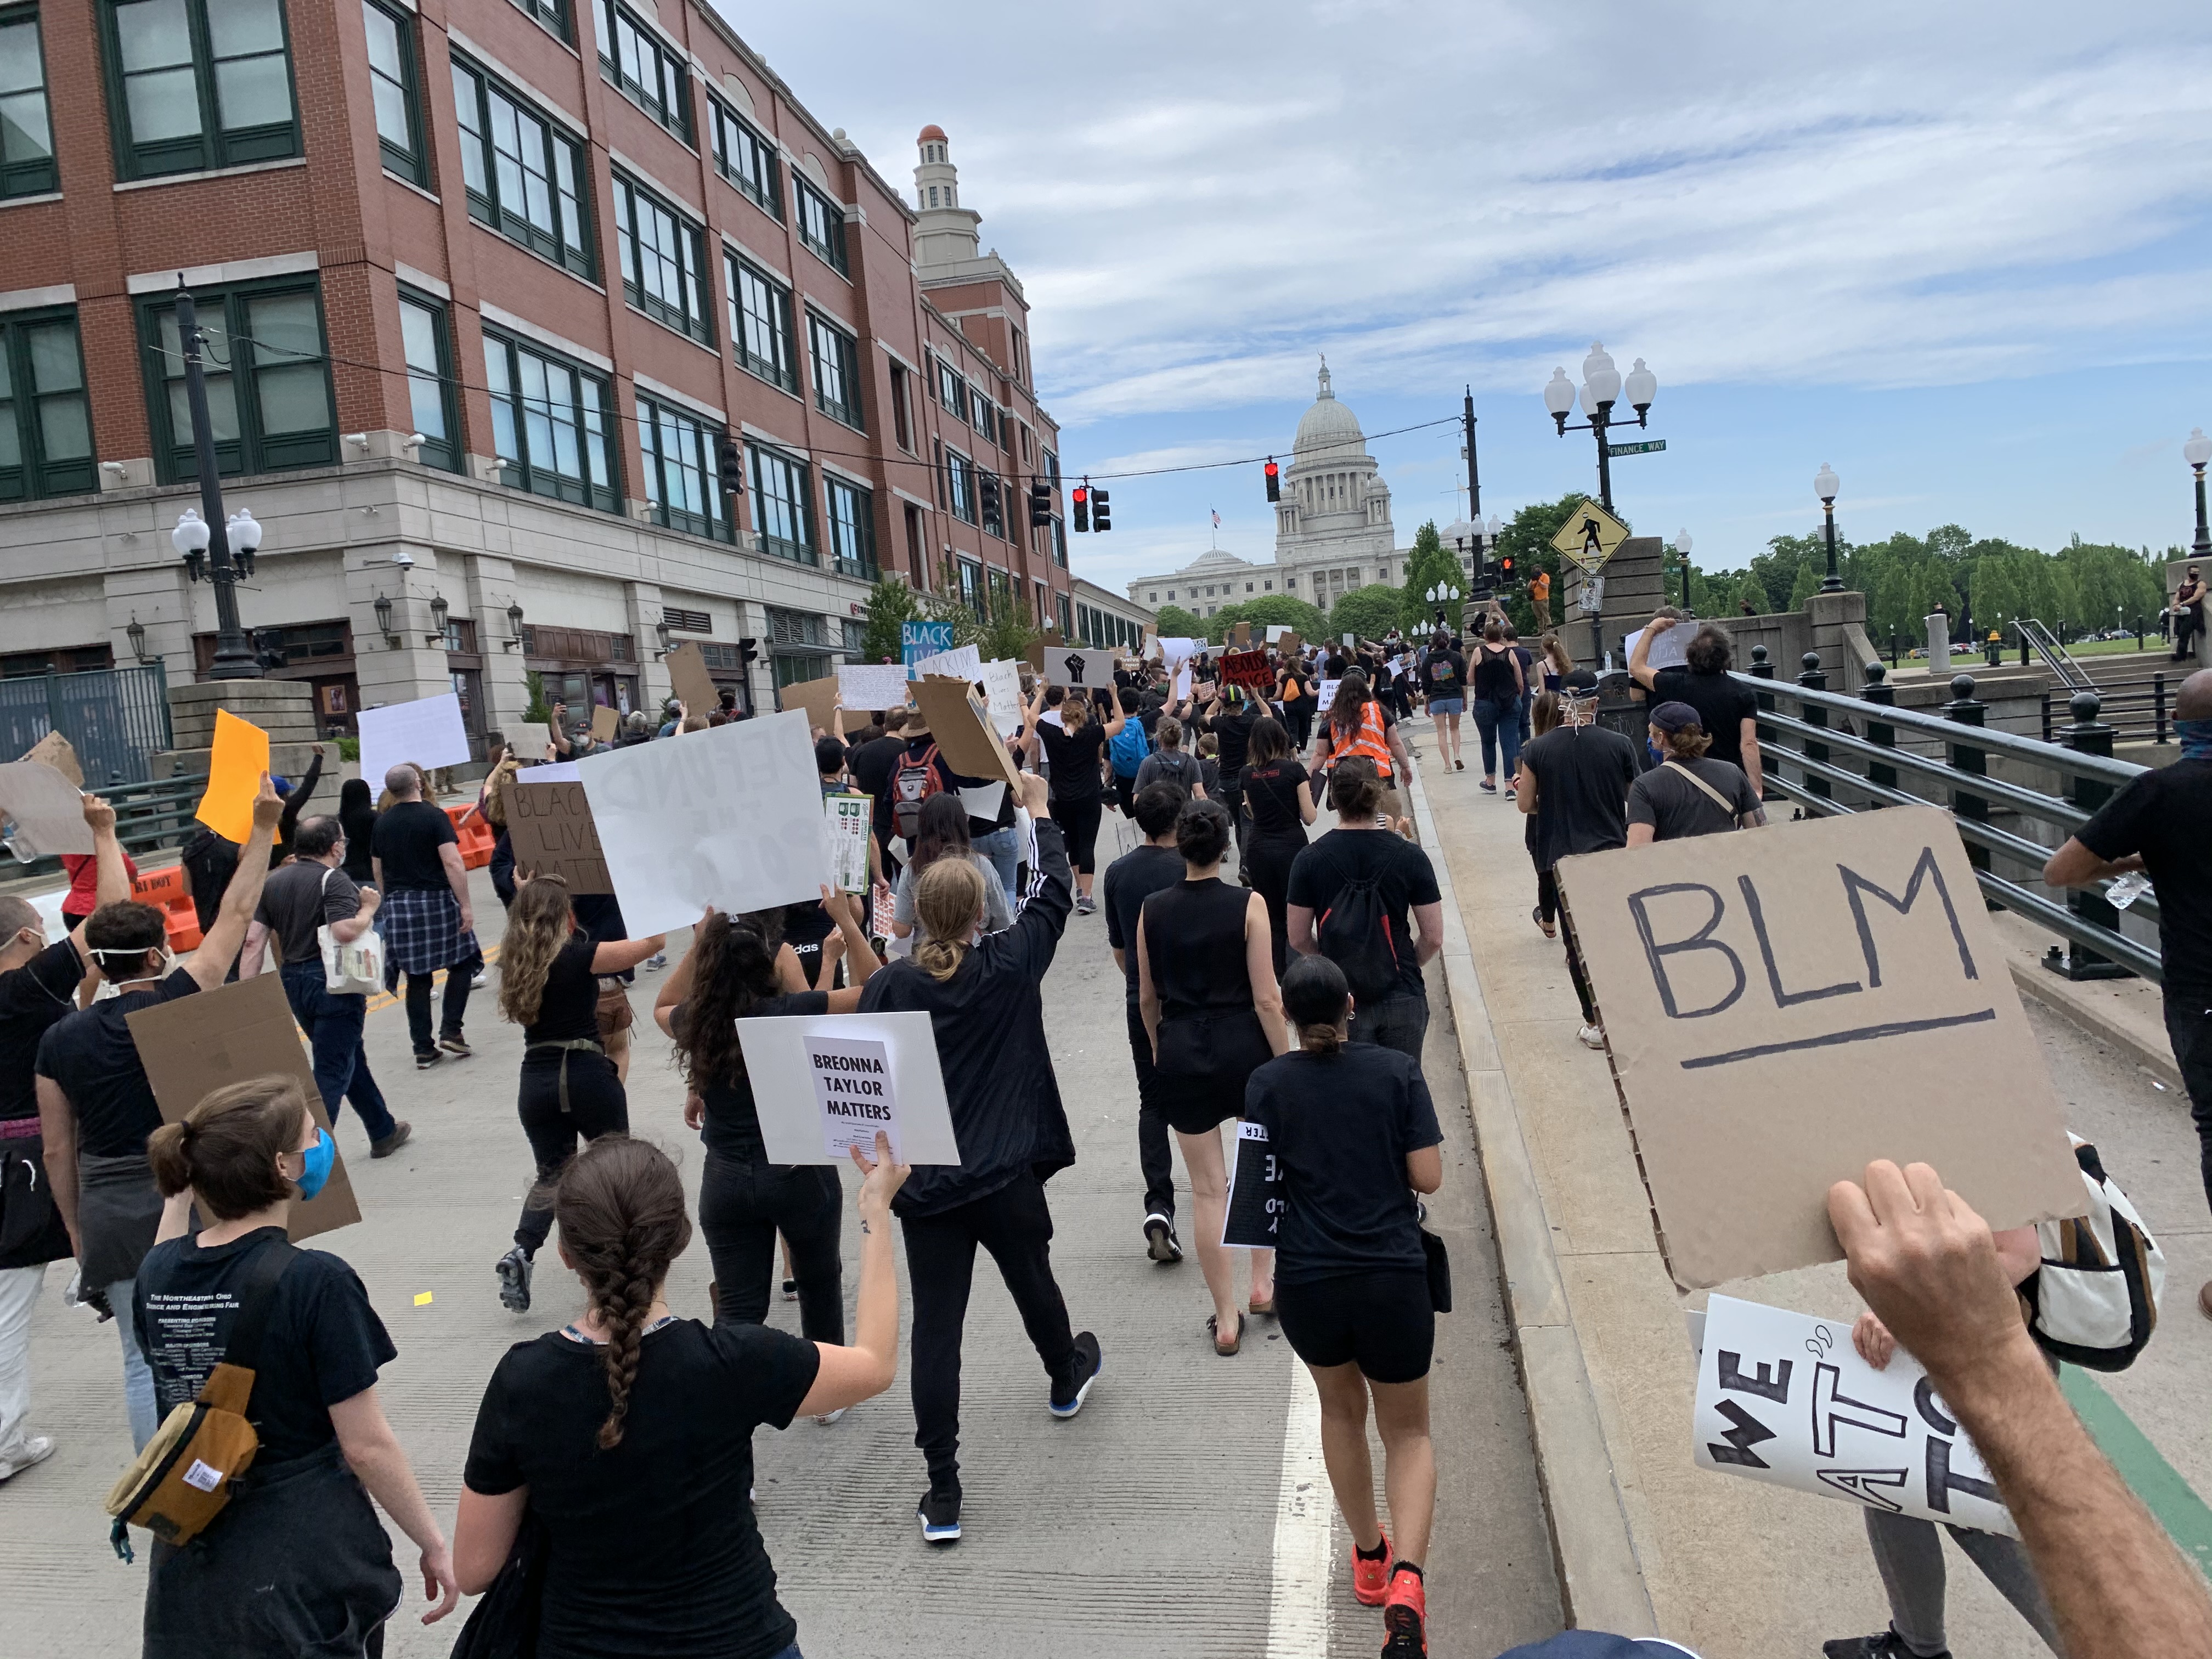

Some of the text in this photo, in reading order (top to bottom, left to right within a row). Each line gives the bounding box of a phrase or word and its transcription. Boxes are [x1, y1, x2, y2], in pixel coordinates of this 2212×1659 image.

[1610, 441, 1664, 456] FINANCE WAY
[902, 624, 951, 647] BLACK
[916, 647, 979, 679] BLACK LIVES
[1224, 653, 1268, 675] ABOLISH
[989, 670, 1013, 682] Black
[1226, 672, 1271, 687] POLICE
[538, 821, 602, 851] LIVE
[135, 881, 148, 894] RI
[1627, 846, 1979, 1019] BLM
[812, 1053, 884, 1074] BREONNA
[823, 1076, 883, 1096] TAYLOR
[827, 1100, 891, 1121] MATTERS
[1707, 1348, 1793, 1469] WE
